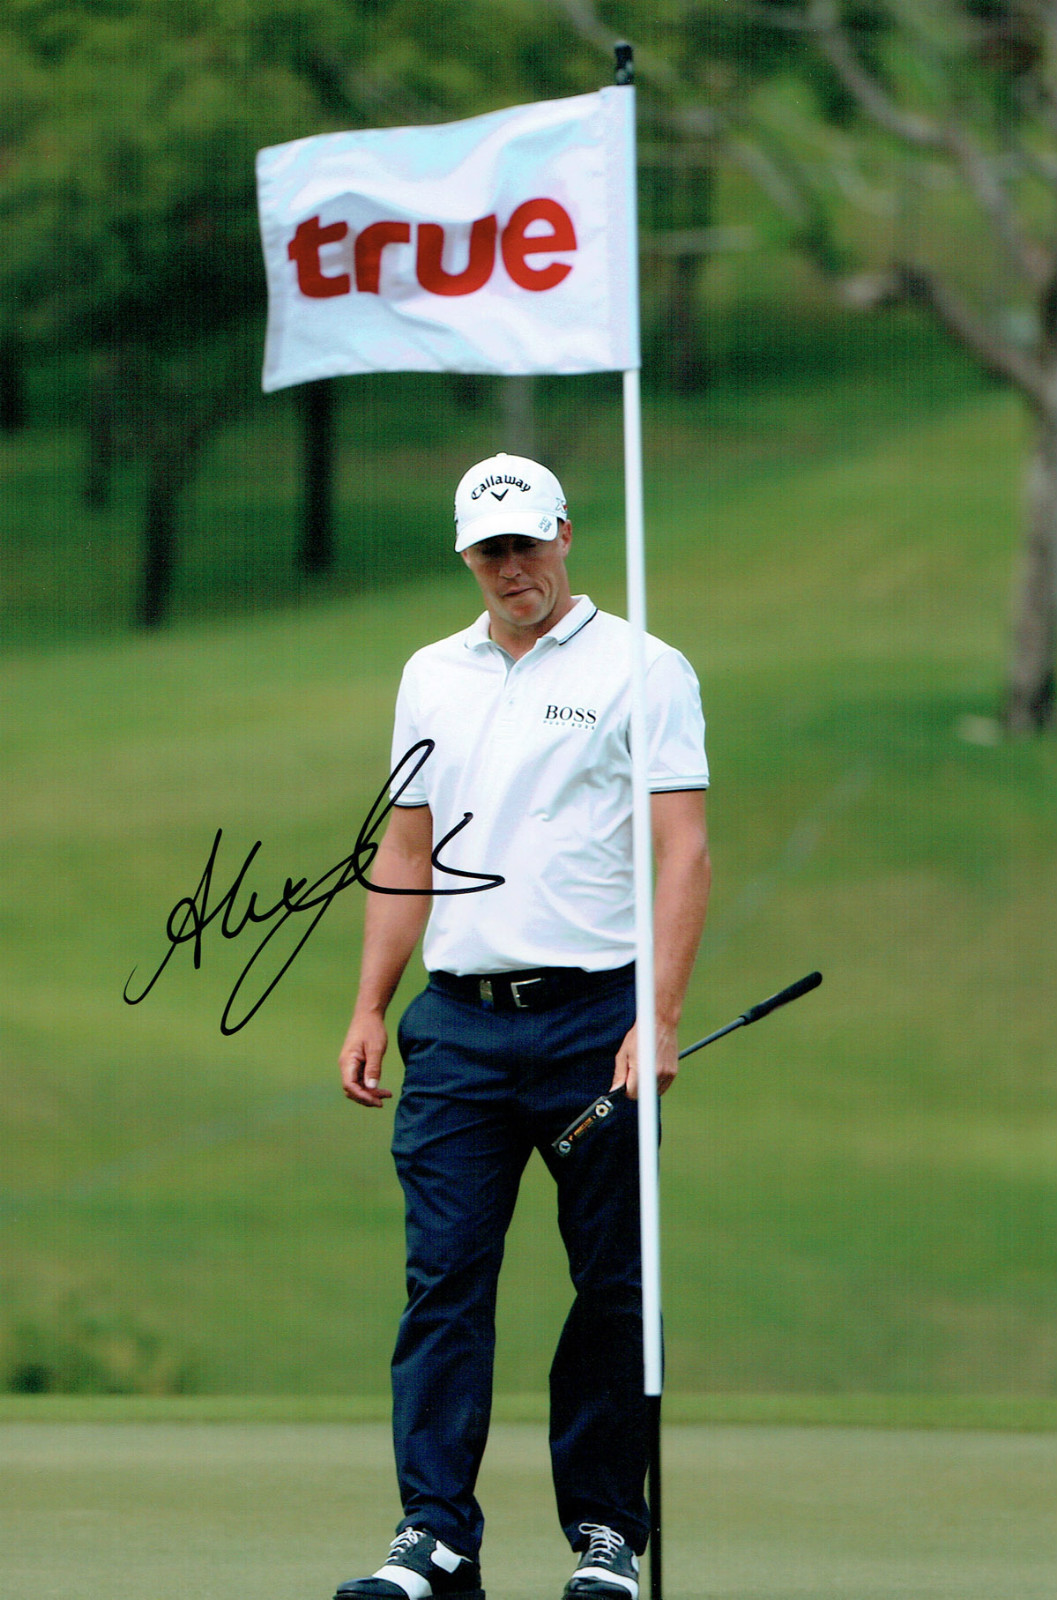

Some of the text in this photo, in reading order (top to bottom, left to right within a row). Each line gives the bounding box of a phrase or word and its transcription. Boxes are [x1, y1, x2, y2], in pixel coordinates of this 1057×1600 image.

[288, 197, 578, 298] true
[471, 474, 531, 500] Callaway
[545, 704, 597, 724] BOSS
